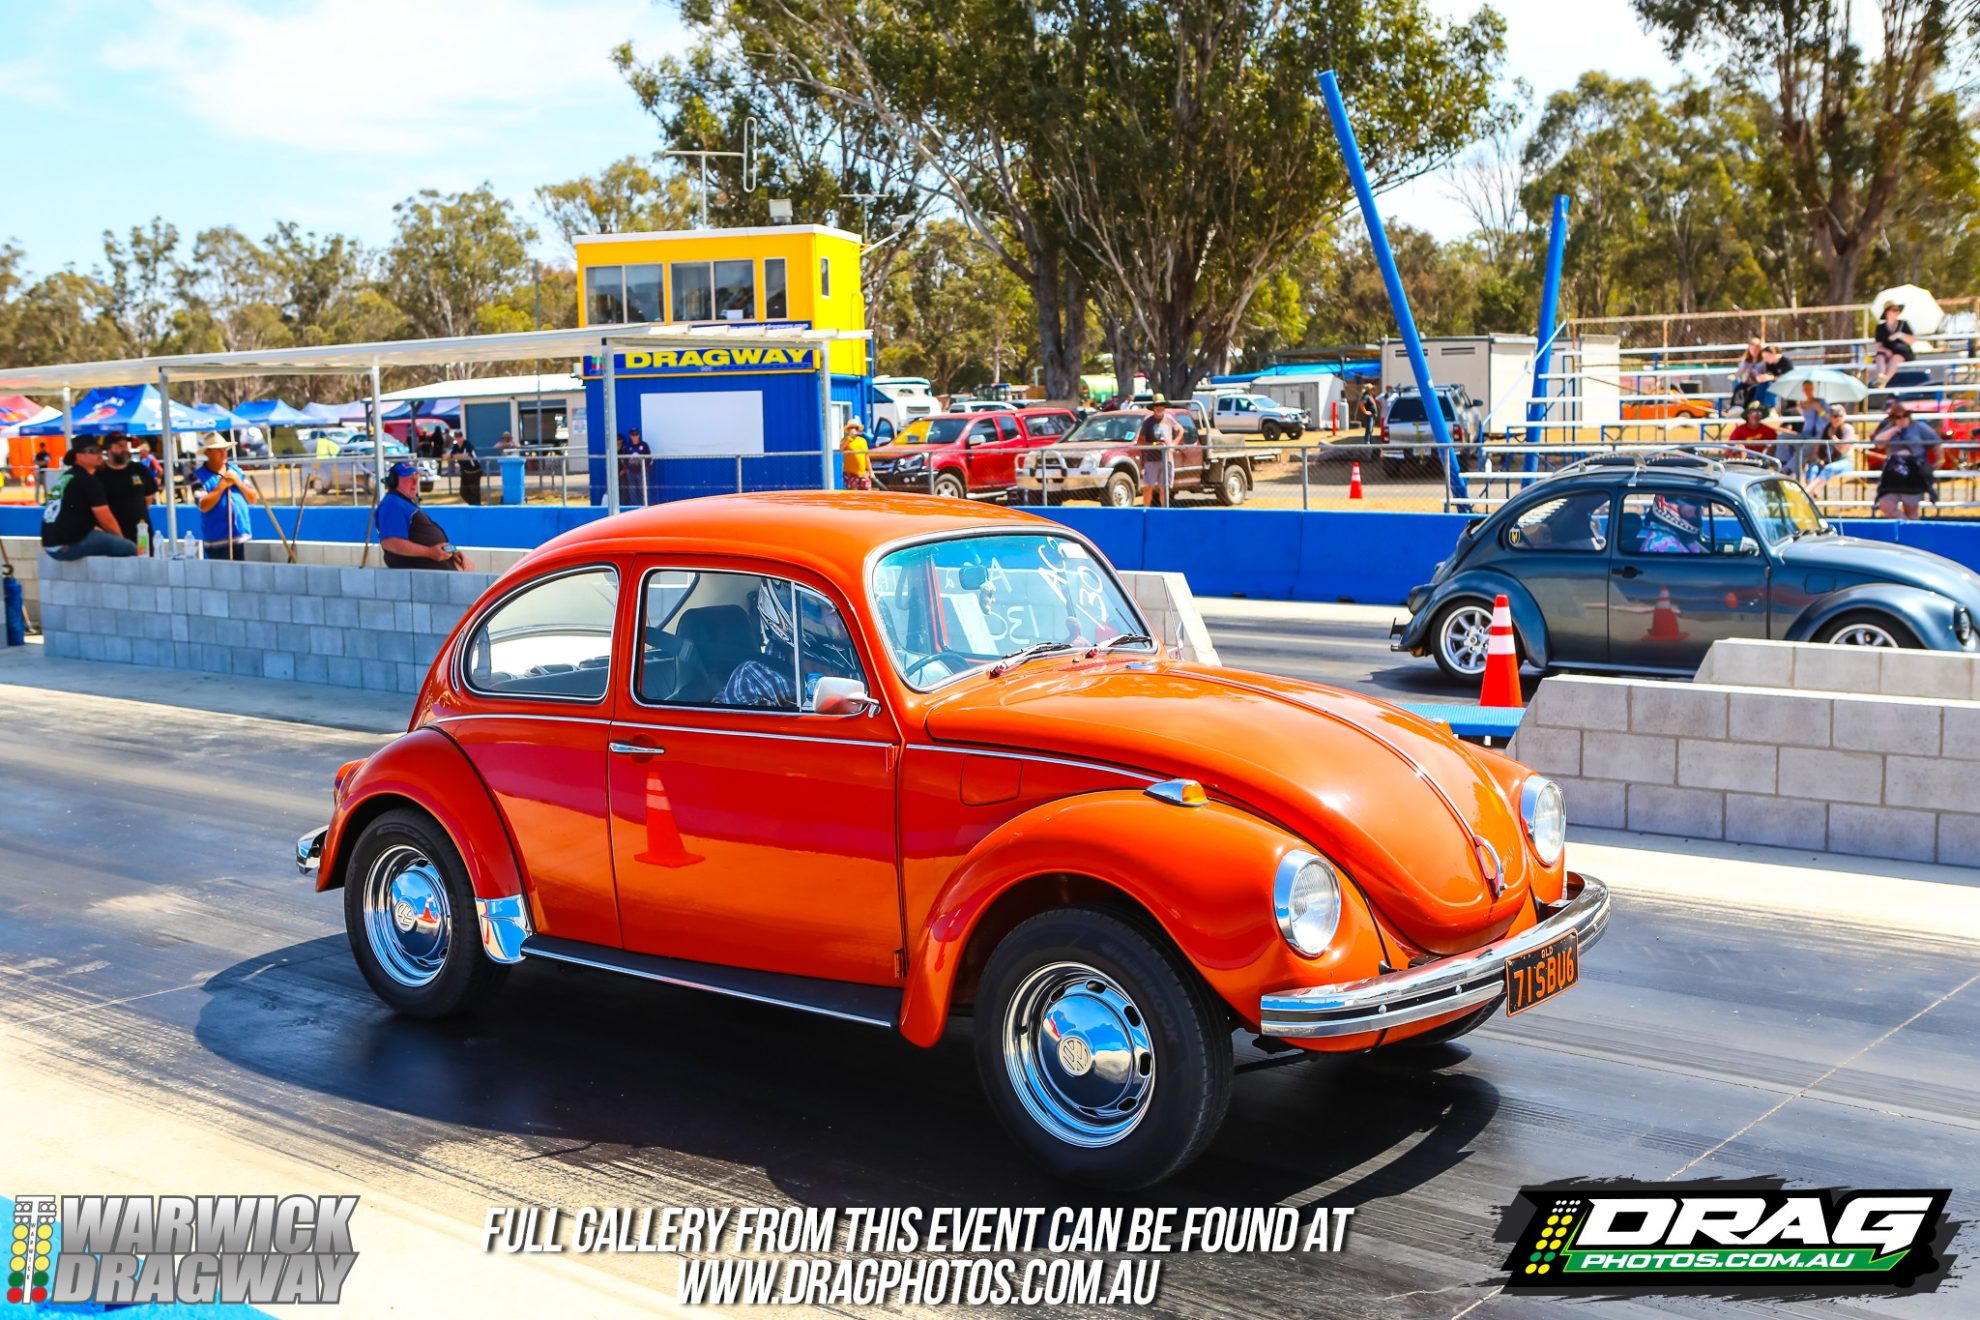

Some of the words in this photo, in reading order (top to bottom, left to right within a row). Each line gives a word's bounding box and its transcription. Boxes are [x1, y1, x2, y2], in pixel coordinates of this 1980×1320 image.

[625, 349, 808, 368] DRAGWAY
[1076, 566, 1107, 631] 130
[1541, 946, 1553, 958] QLD
